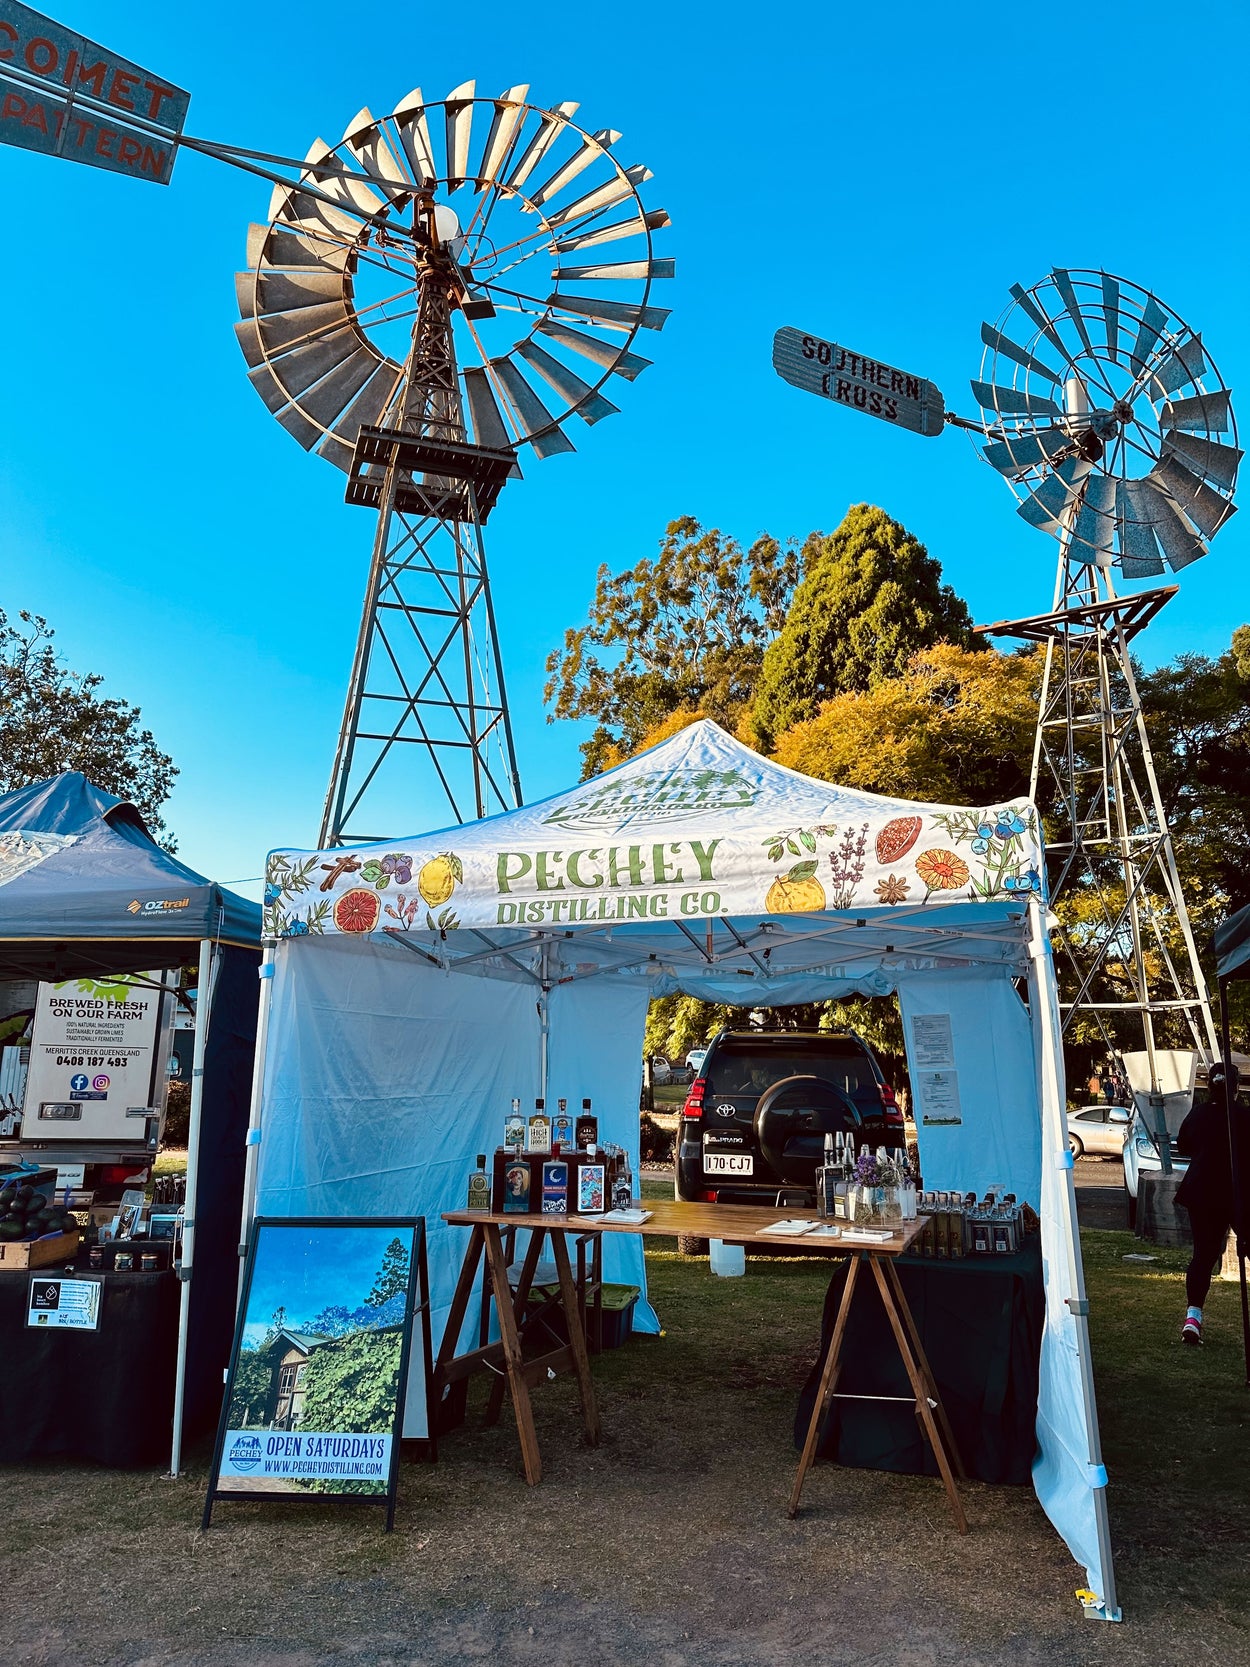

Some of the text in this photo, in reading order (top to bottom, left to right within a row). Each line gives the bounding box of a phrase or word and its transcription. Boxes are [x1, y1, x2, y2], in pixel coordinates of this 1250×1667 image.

[0, 21, 174, 120] COMET
[2, 92, 166, 176] PATTERN
[496, 838, 725, 894] PECHEY
[144, 898, 190, 910] OZtrail
[496, 891, 729, 925] DISTILLING CO.
[49, 998, 149, 1011] BREWED FRESH
[53, 1008, 143, 1020] ON OUR FARM
[46, 1047, 141, 1057] MERRITTS CREEK QUEENSLAND
[56, 1056, 128, 1067] 0408 187 493
[229, 1449, 264, 1458] PECHEY
[266, 1436, 385, 1459] OPEN SATURDAYS
[264, 1460, 383, 1475] WWW.PECHEYDISTILLING.COM
